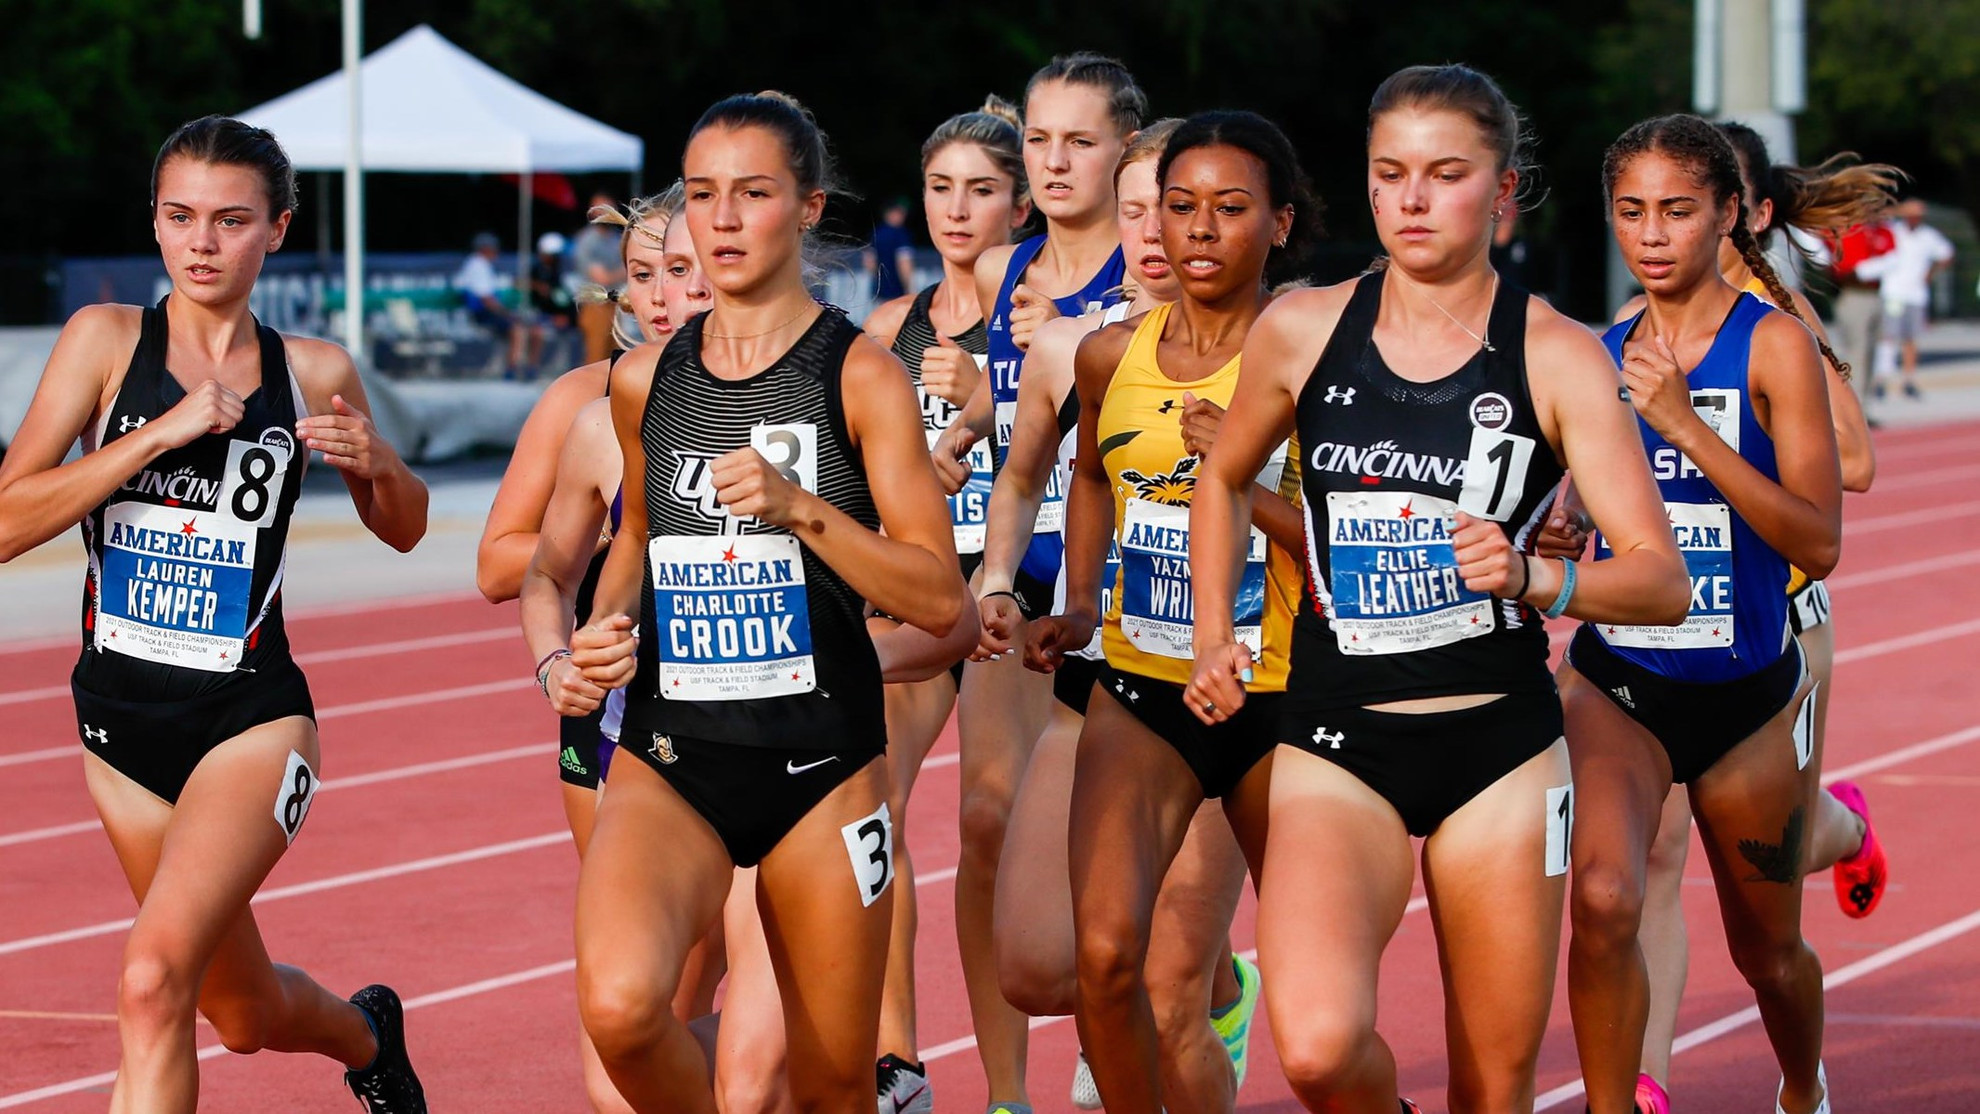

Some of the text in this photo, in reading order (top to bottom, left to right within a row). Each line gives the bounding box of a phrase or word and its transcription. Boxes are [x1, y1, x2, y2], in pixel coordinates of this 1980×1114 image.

[232, 448, 276, 522] 8
[1485, 439, 1515, 515] 1
[110, 522, 246, 564] AMERICAN
[1335, 517, 1454, 542] AMERICA
[136, 558, 214, 589] LAUREN
[658, 559, 794, 587] AMERICAN
[1376, 549, 1430, 572] ELLIE
[127, 578, 218, 630] KEMPER
[672, 591, 786, 616] CHARLOTTE
[1150, 576, 1194, 621] WRI
[1357, 567, 1460, 615] LEATHER
[1139, 619, 1163, 630] OUTDOOR
[1164, 623, 1182, 633] TRACK
[1384, 620, 1406, 629] TRACK
[1414, 617, 1433, 626] FIELD
[1433, 603, 1486, 623] CHAMPIONSHIPS
[1684, 617, 1727, 625] HAMPIONSHIPS
[118, 619, 142, 632] OUTDOOR
[143, 626, 162, 637] TRACK
[168, 631, 186, 641] FIELD
[187, 634, 237, 648] CHAMPIONSHIPS
[139, 635, 156, 645] TRACK
[163, 641, 180, 650] FIELD
[181, 643, 208, 653] STADIUM
[669, 614, 798, 659] CROOK
[1160, 633, 1177, 642] TRACK
[1382, 629, 1405, 638] TRACK
[1411, 626, 1430, 635] FIELD
[678, 665, 705, 674] OUTDOOR
[706, 665, 727, 674] TRACK
[735, 664, 752, 673] FIELD
[753, 658, 807, 672] CHAMPIONSHIPS
[702, 676, 724, 684] TRACK
[731, 675, 749, 683] FIELD
[750, 673, 778, 682] STADIUM
[284, 764, 311, 834] 8
[1557, 790, 1570, 868] 1
[857, 818, 888, 896] 3
